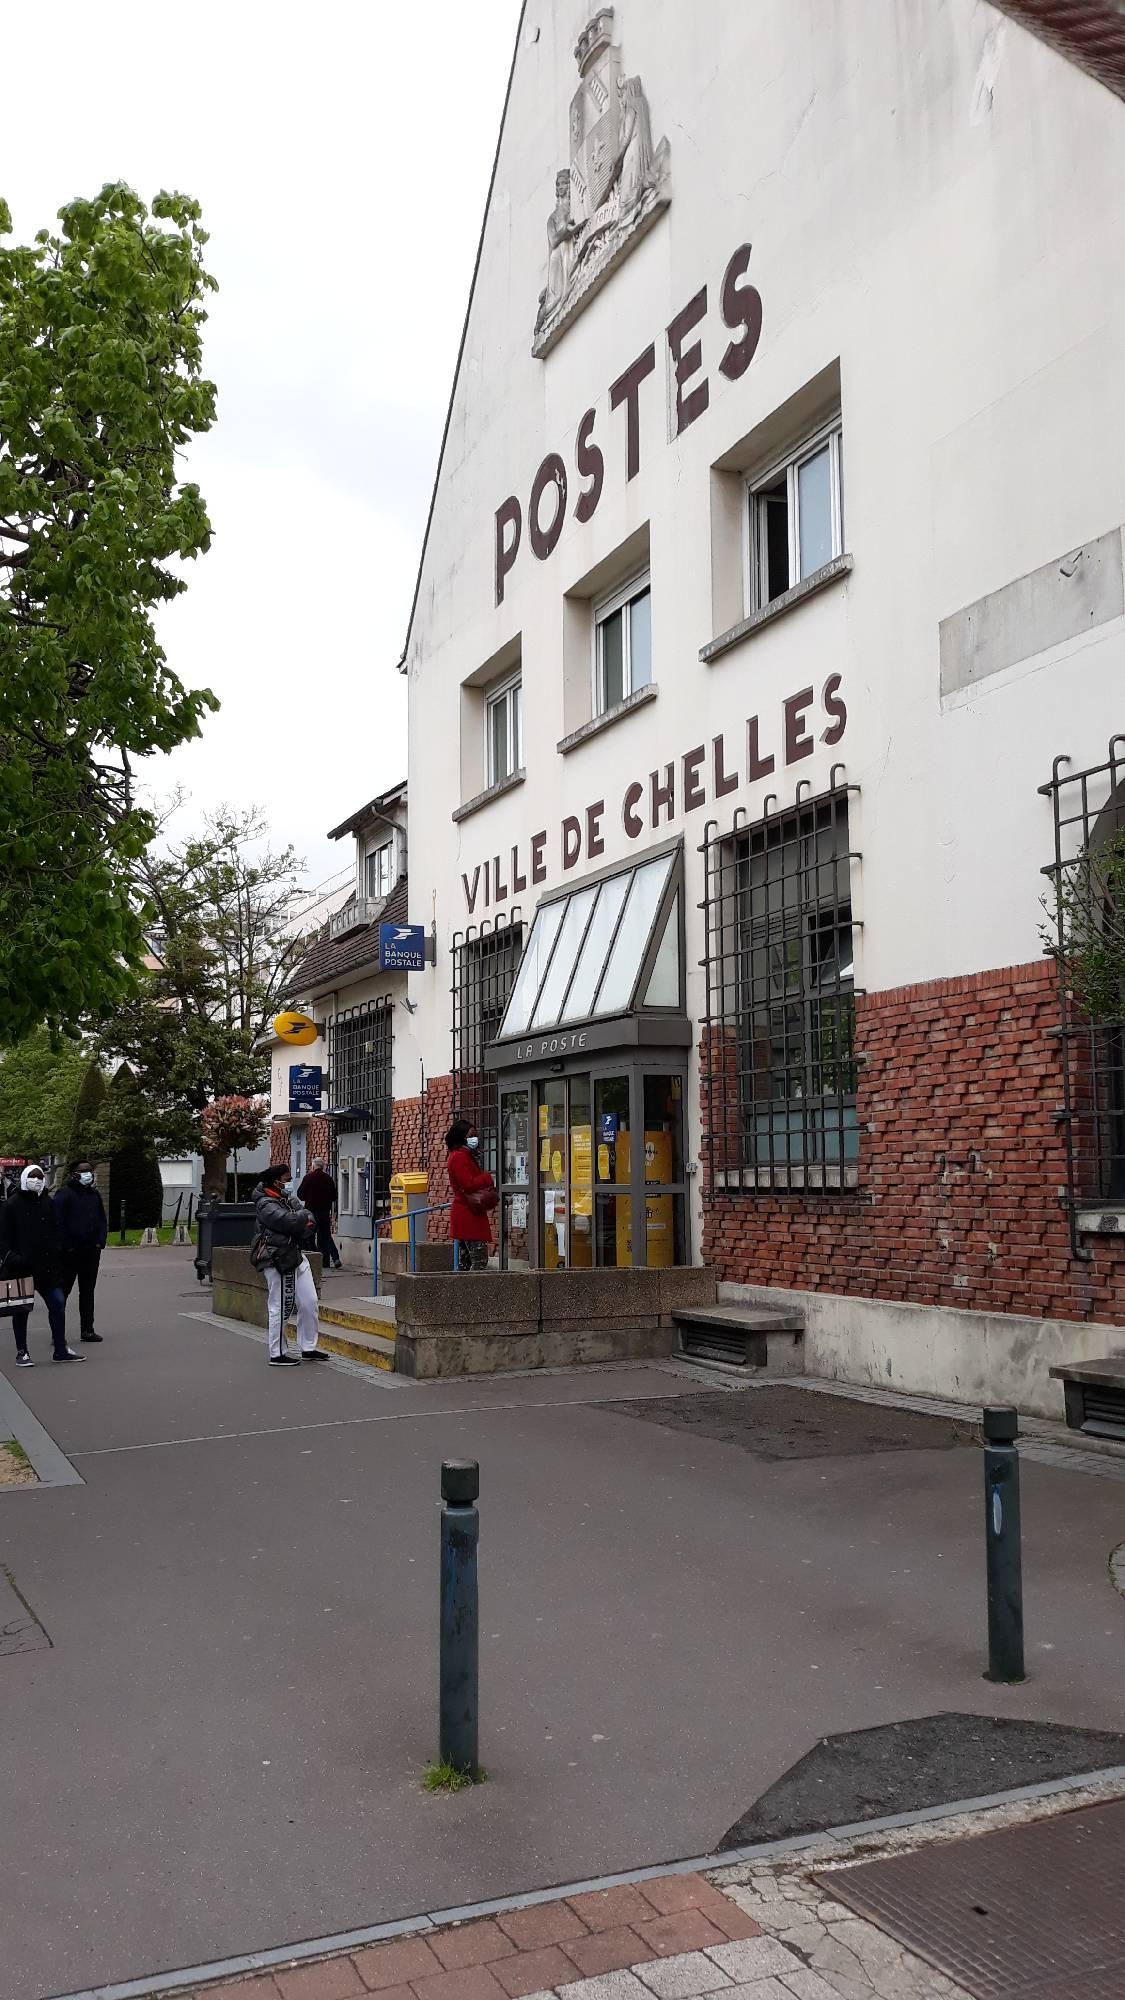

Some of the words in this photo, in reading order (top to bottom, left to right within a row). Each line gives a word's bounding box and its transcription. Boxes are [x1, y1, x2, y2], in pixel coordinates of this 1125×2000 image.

[494, 242, 763, 608] POSTES
[461, 829, 547, 914] VILLE
[561, 799, 605, 871] DE
[622, 672, 848, 839] CHELLES
[384, 942, 397, 950] LA
[384, 951, 422, 959] BANQUE
[384, 958, 422, 967] POSTALE
[517, 1045, 533, 1059] LA
[541, 1033, 588, 1055] POSTE
